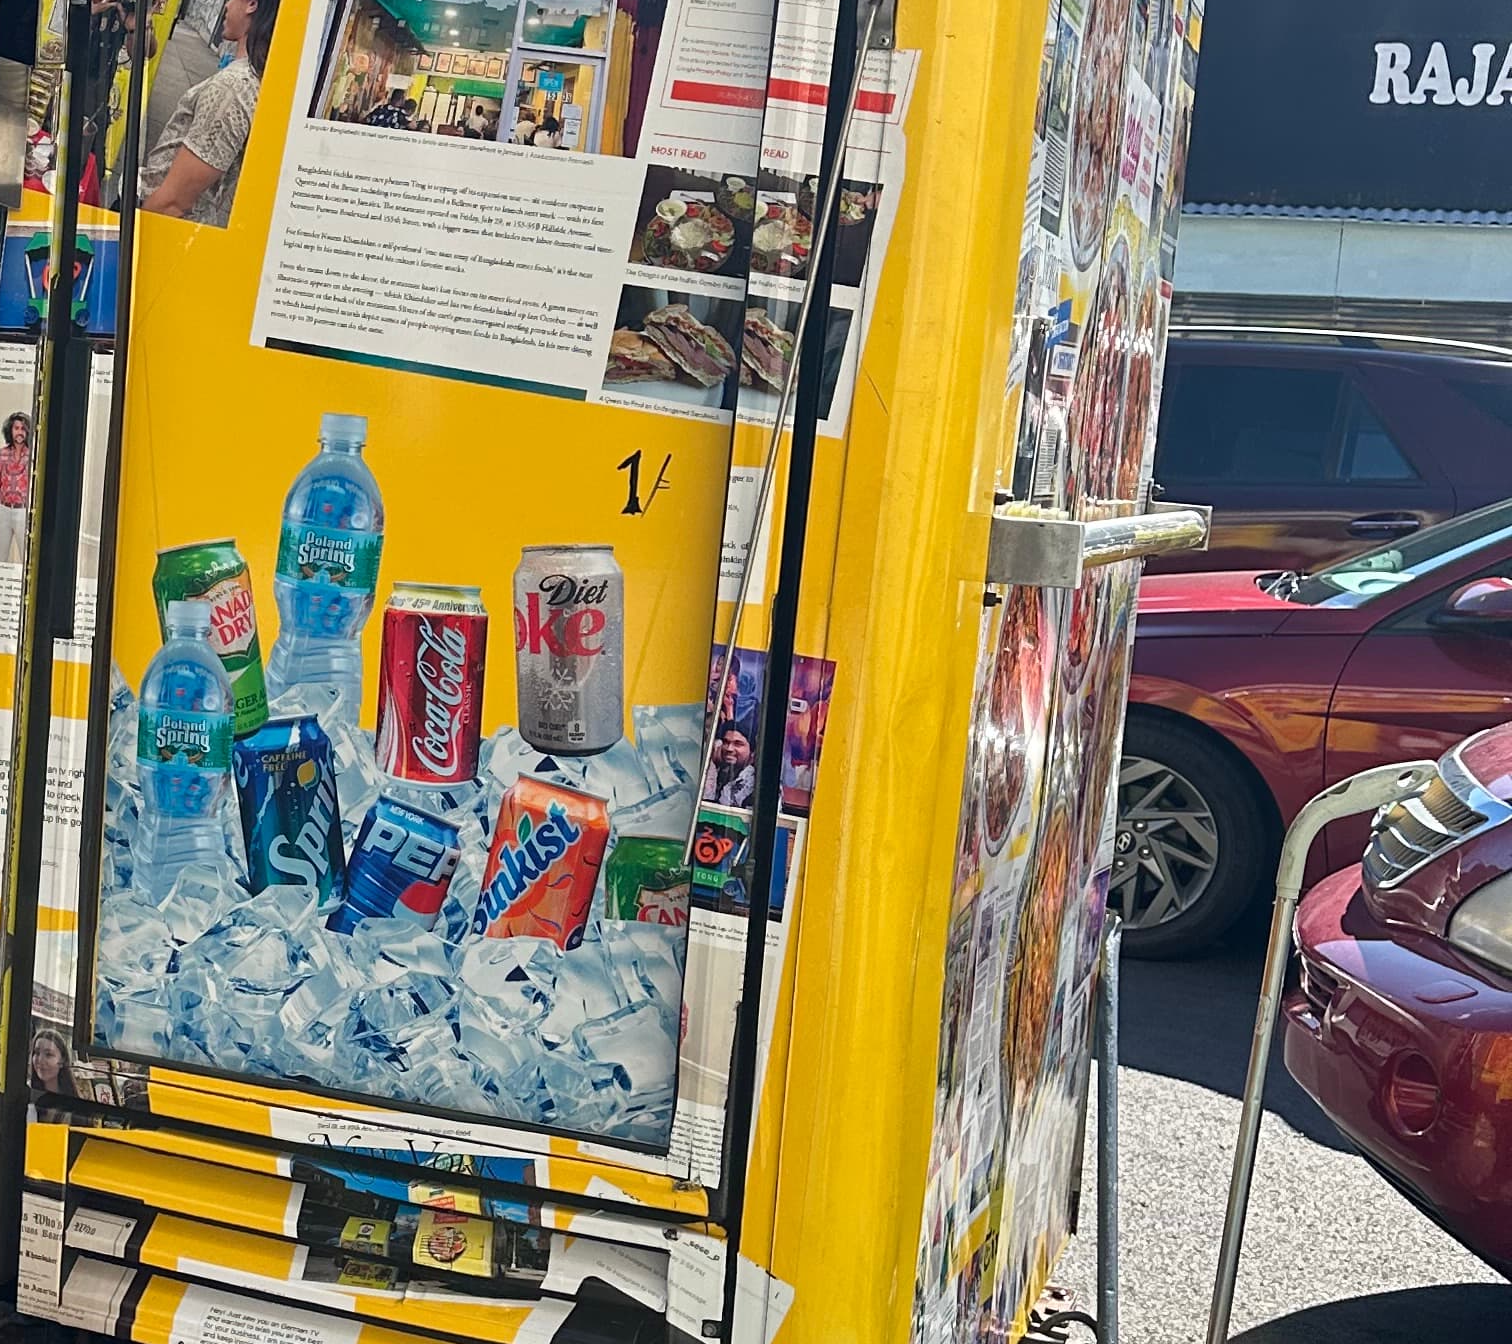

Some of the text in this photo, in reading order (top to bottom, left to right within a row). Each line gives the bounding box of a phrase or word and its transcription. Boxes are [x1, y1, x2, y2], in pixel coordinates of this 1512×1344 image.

[650, 144, 707, 161] MOST READ
[306, 530, 352, 551] Poland
[298, 544, 355, 572] Spring
[539, 574, 608, 606] Diet
[218, 612, 252, 646] DRY
[463, 682, 473, 724] CLASSIC
[163, 715, 206, 732] Poland
[156, 727, 210, 753] Spring
